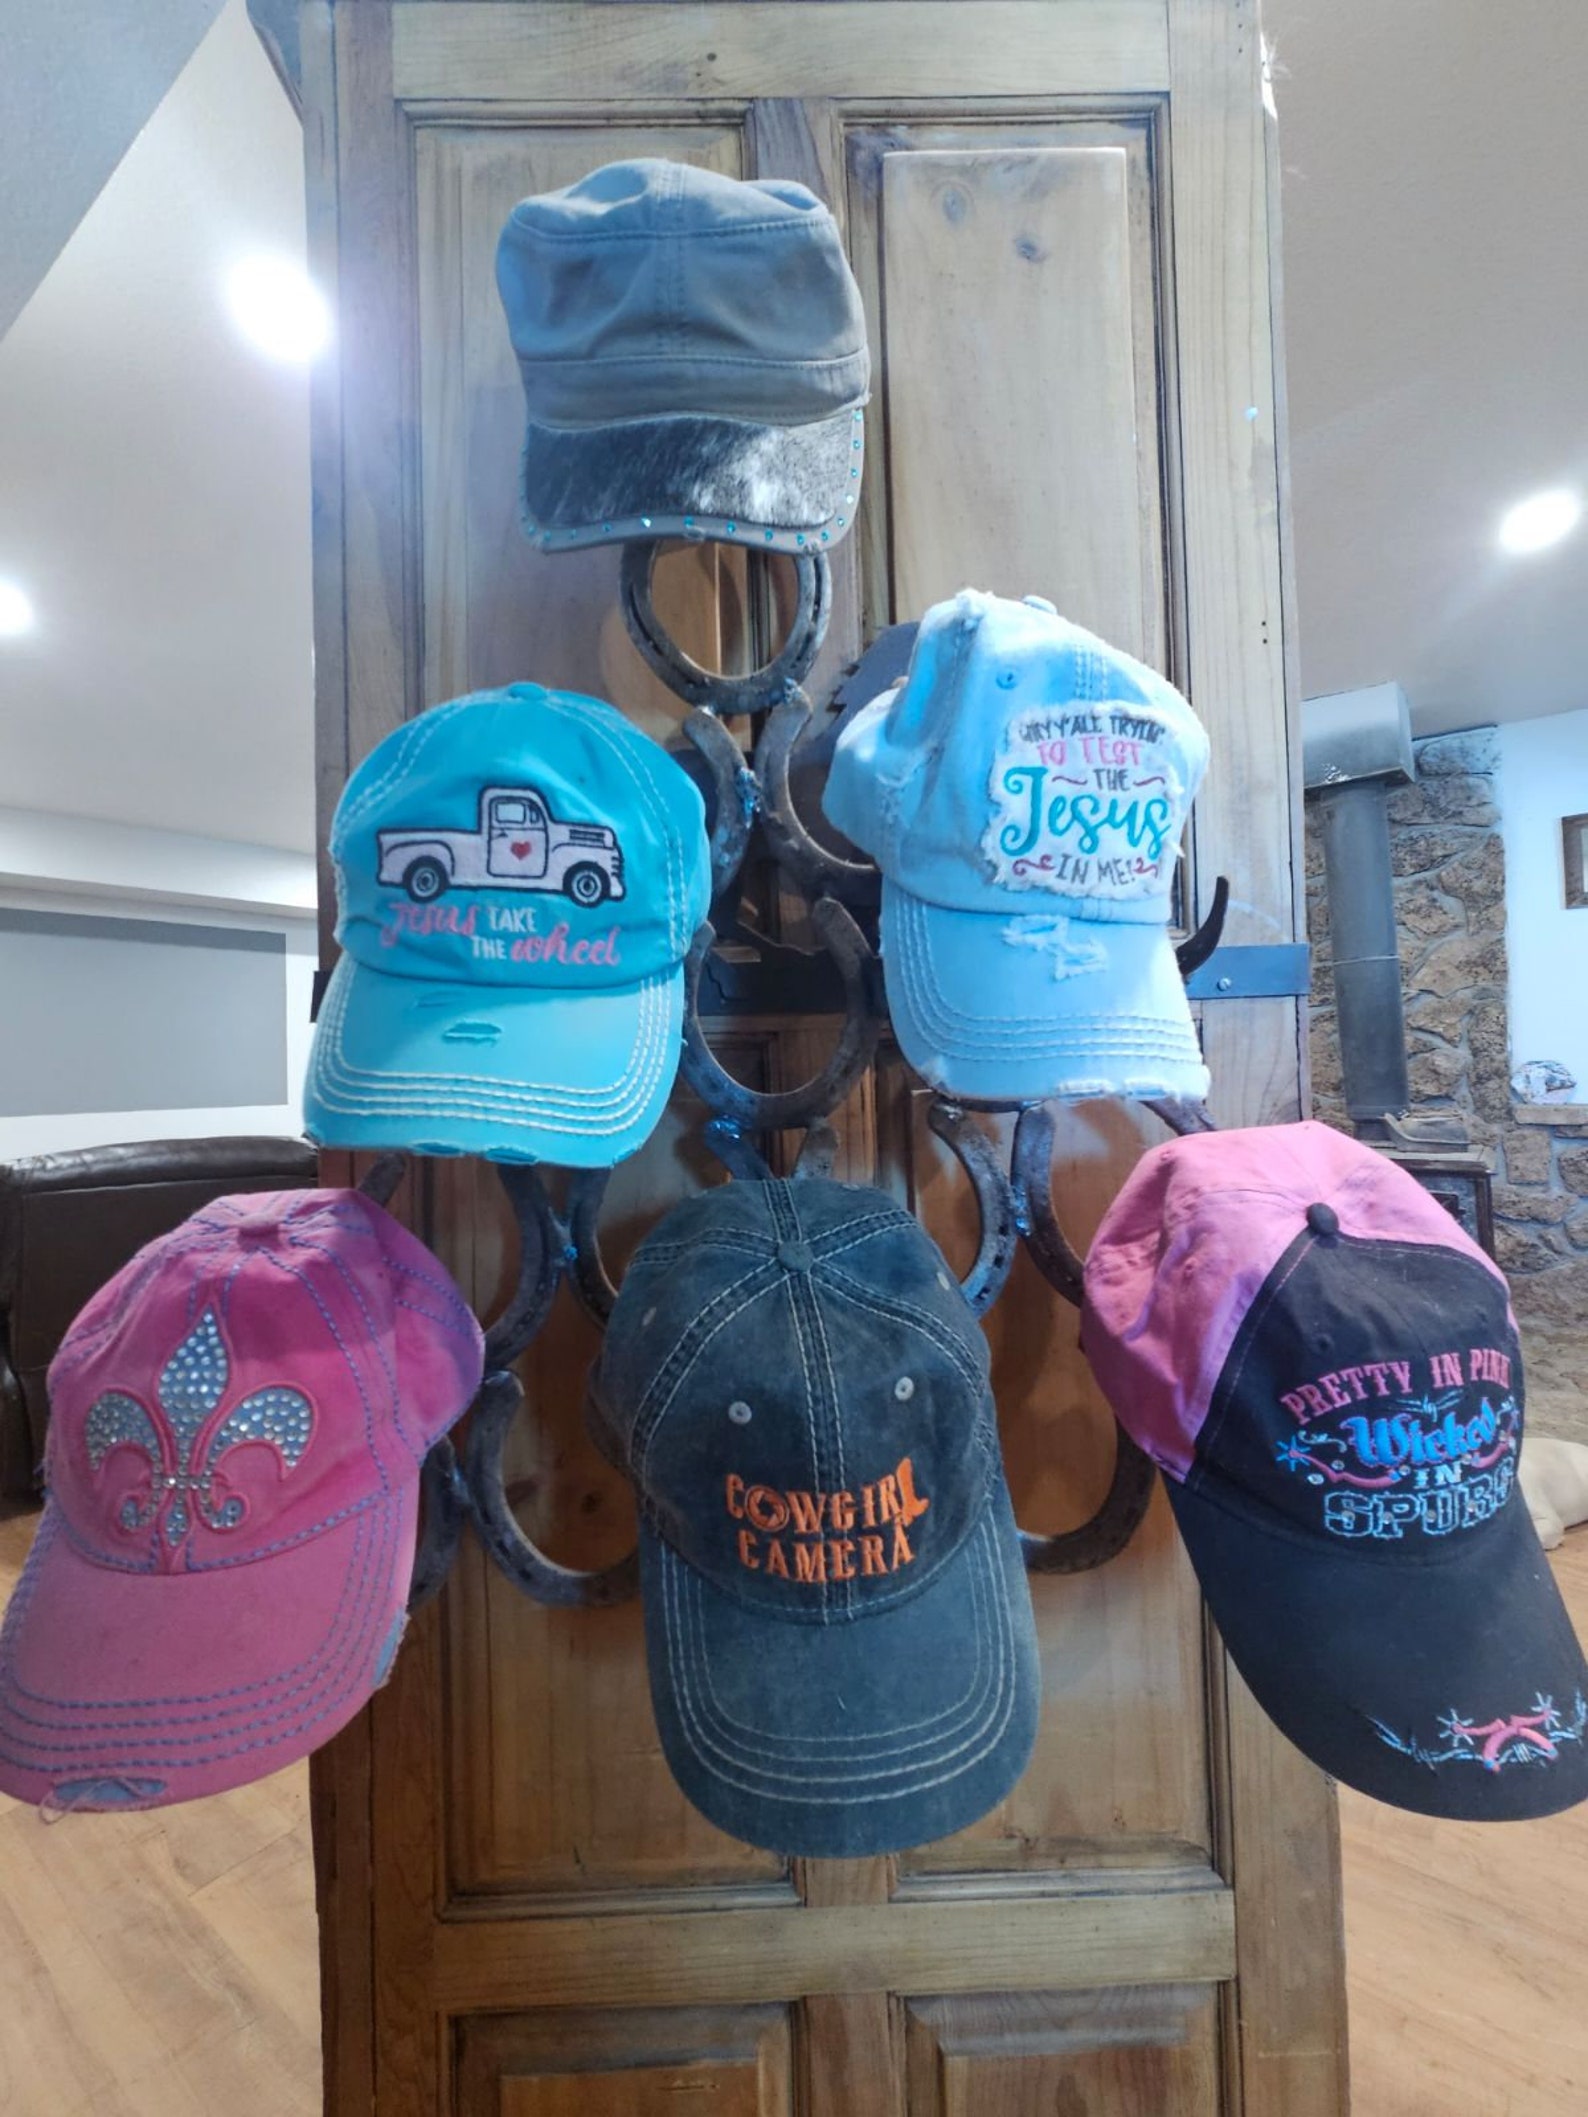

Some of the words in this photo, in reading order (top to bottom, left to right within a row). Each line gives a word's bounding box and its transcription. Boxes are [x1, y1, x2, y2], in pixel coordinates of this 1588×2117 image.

[1036, 740, 1067, 766] TO
[1080, 735, 1142, 766] TEST
[1093, 768, 1130, 792] THE
[1001, 766, 1171, 860] Jesus
[1056, 853, 1090, 885] IN
[1098, 857, 1136, 887] ME!
[488, 906, 538, 934] TAKE
[471, 935, 508, 961] THE
[510, 921, 621, 967] wheel
[1280, 1360, 1413, 1426] PRETTY
[1429, 1352, 1465, 1389] IN
[1413, 1461, 1463, 1490] IN
[1324, 1456, 1515, 1540] SPURS
[738, 1514, 915, 1584] CAMERA
